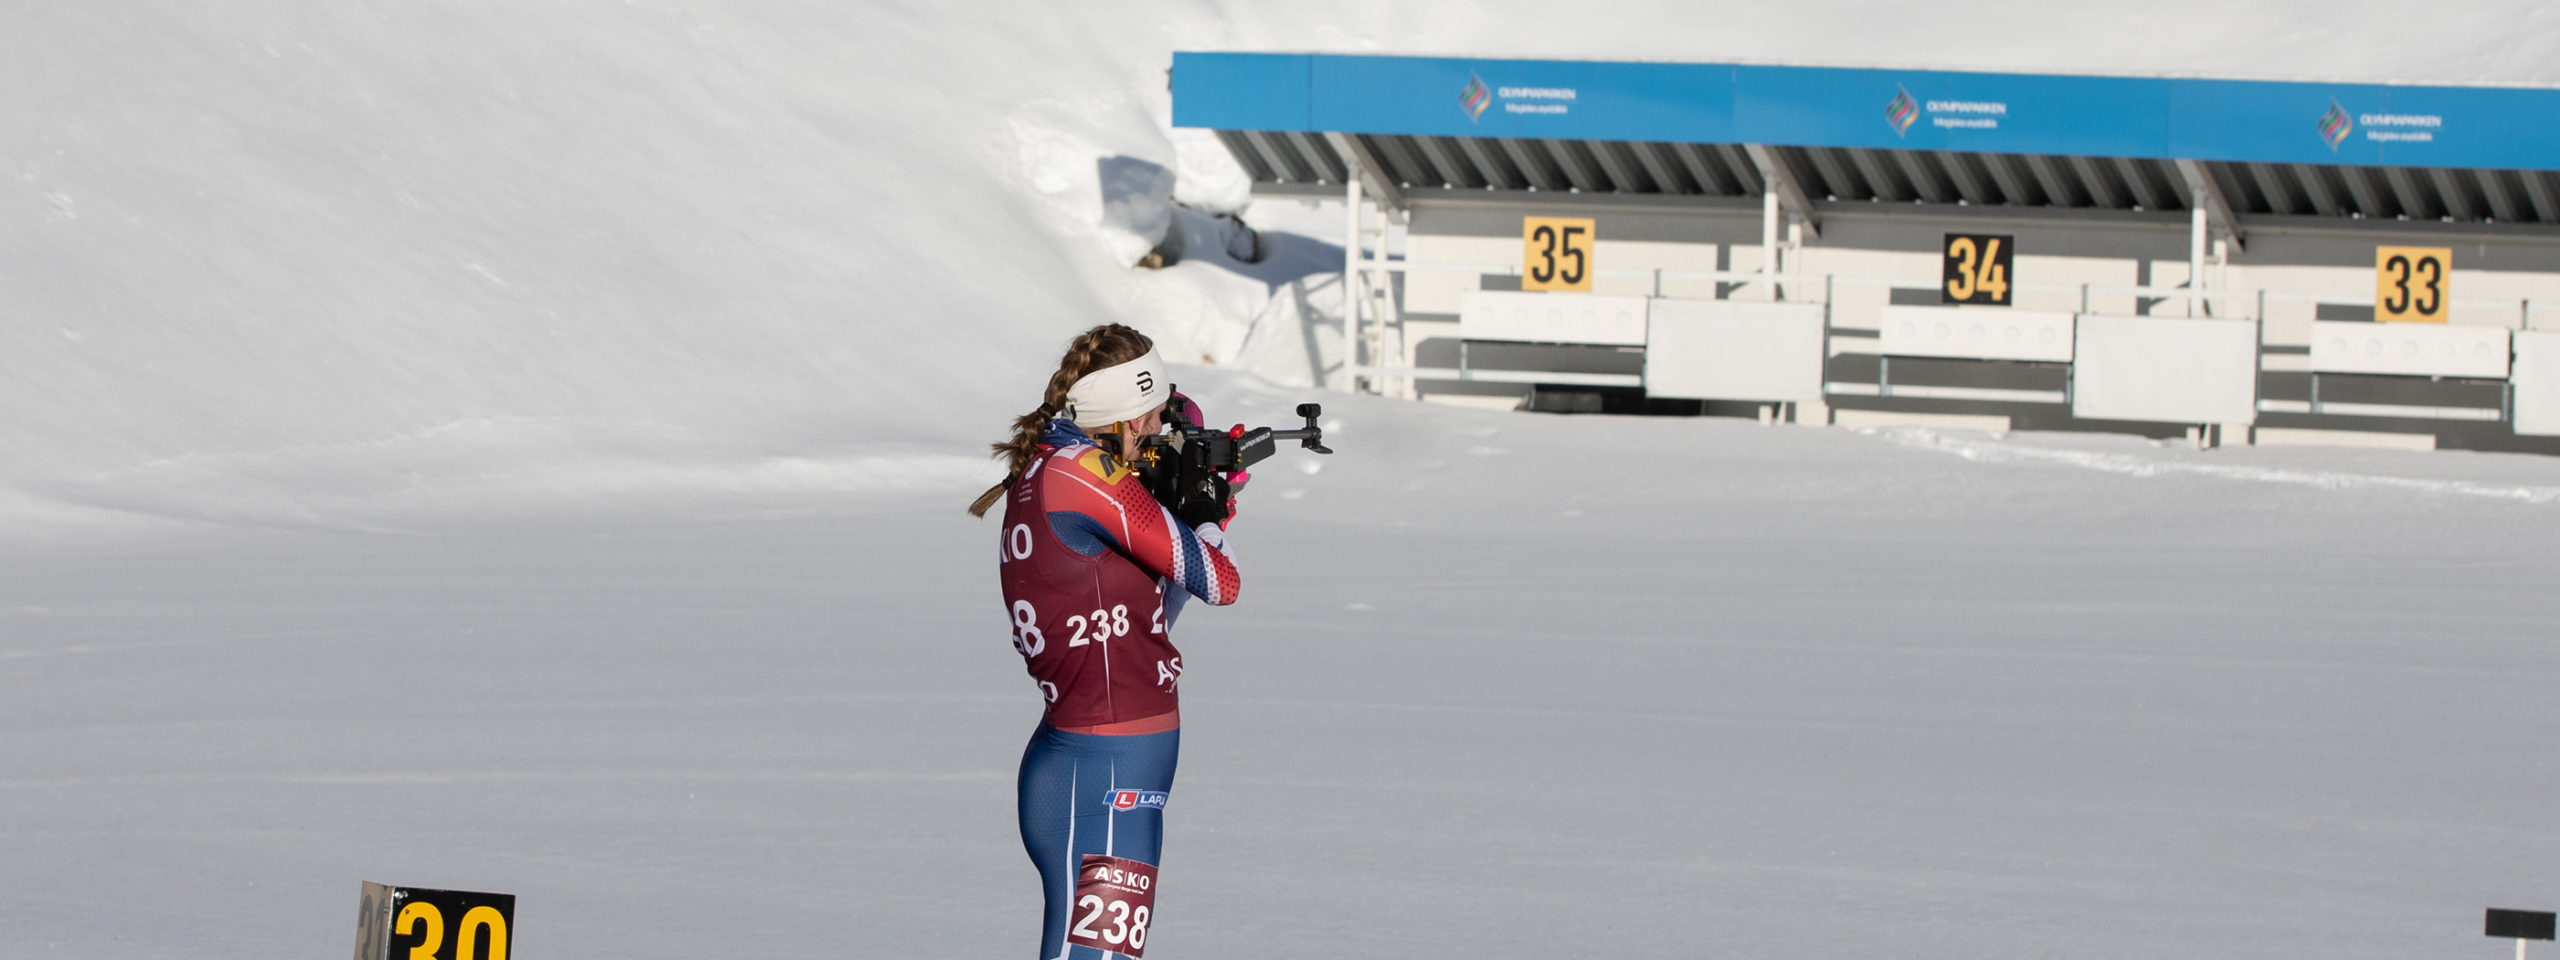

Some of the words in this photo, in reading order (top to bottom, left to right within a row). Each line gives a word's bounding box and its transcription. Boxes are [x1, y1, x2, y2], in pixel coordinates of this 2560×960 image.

[1532, 225, 1585, 284] 35
[1948, 237, 2007, 301] 34
[2385, 254, 2441, 315] 33
[1066, 604, 1130, 648] 238
[1094, 866, 1150, 890] ASKO
[395, 901, 507, 960] 30
[1072, 894, 1150, 950] 238
